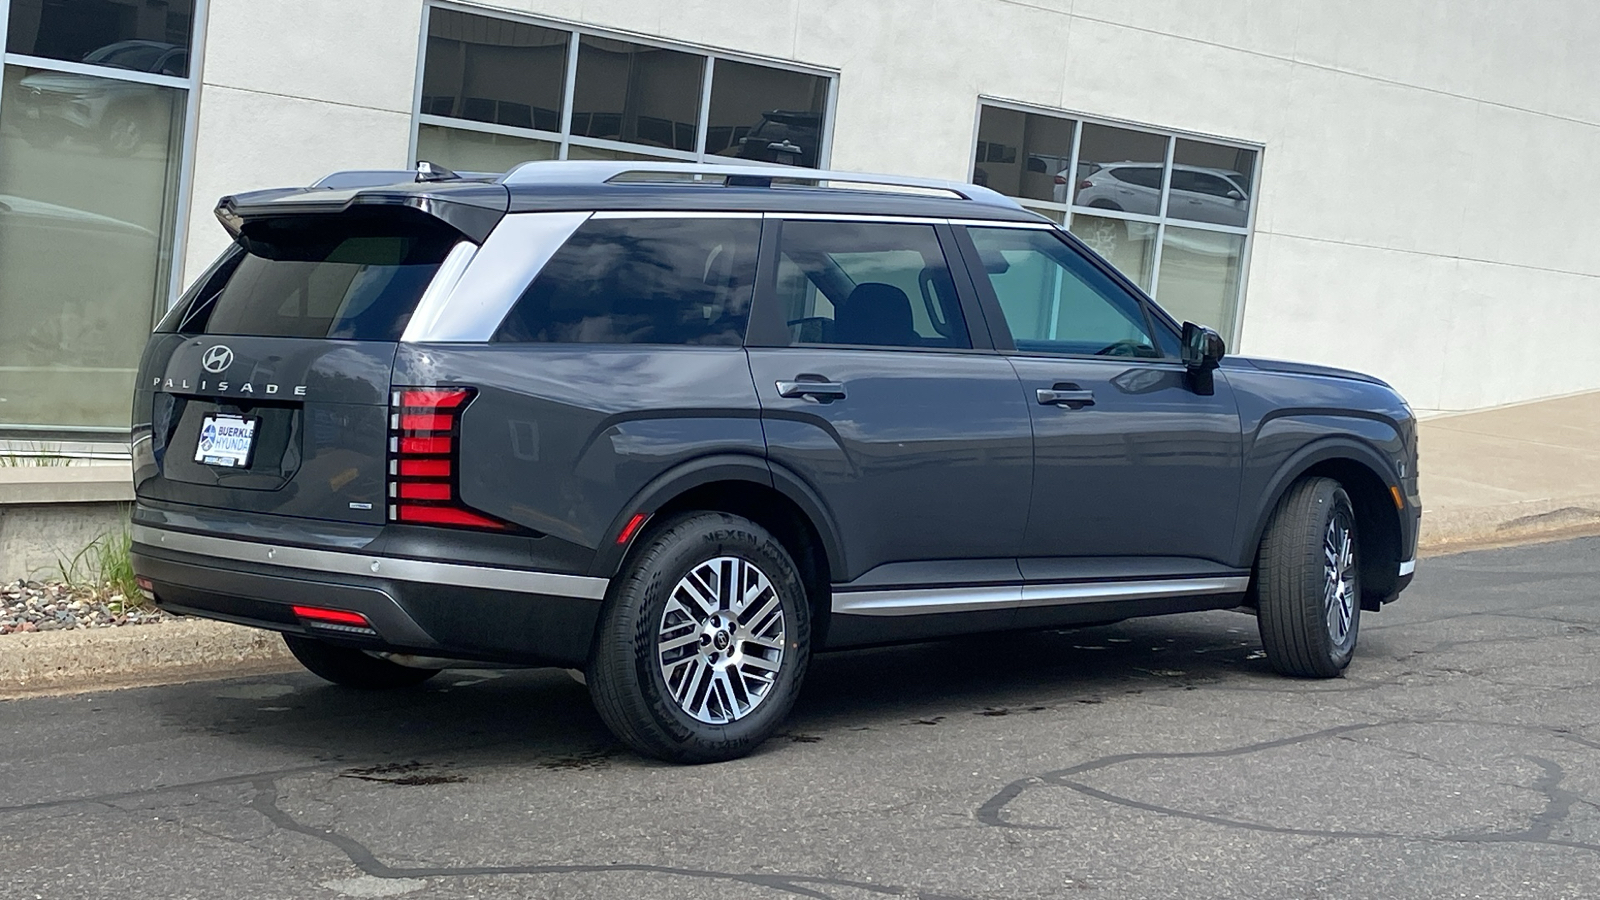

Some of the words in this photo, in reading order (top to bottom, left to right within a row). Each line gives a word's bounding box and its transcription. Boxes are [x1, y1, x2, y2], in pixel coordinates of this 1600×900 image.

[153, 377, 308, 396] PALISADE
[218, 426, 254, 438] BUERKLE
[215, 437, 249, 451] HYUNDA
[702, 529, 757, 545] NEXEN
